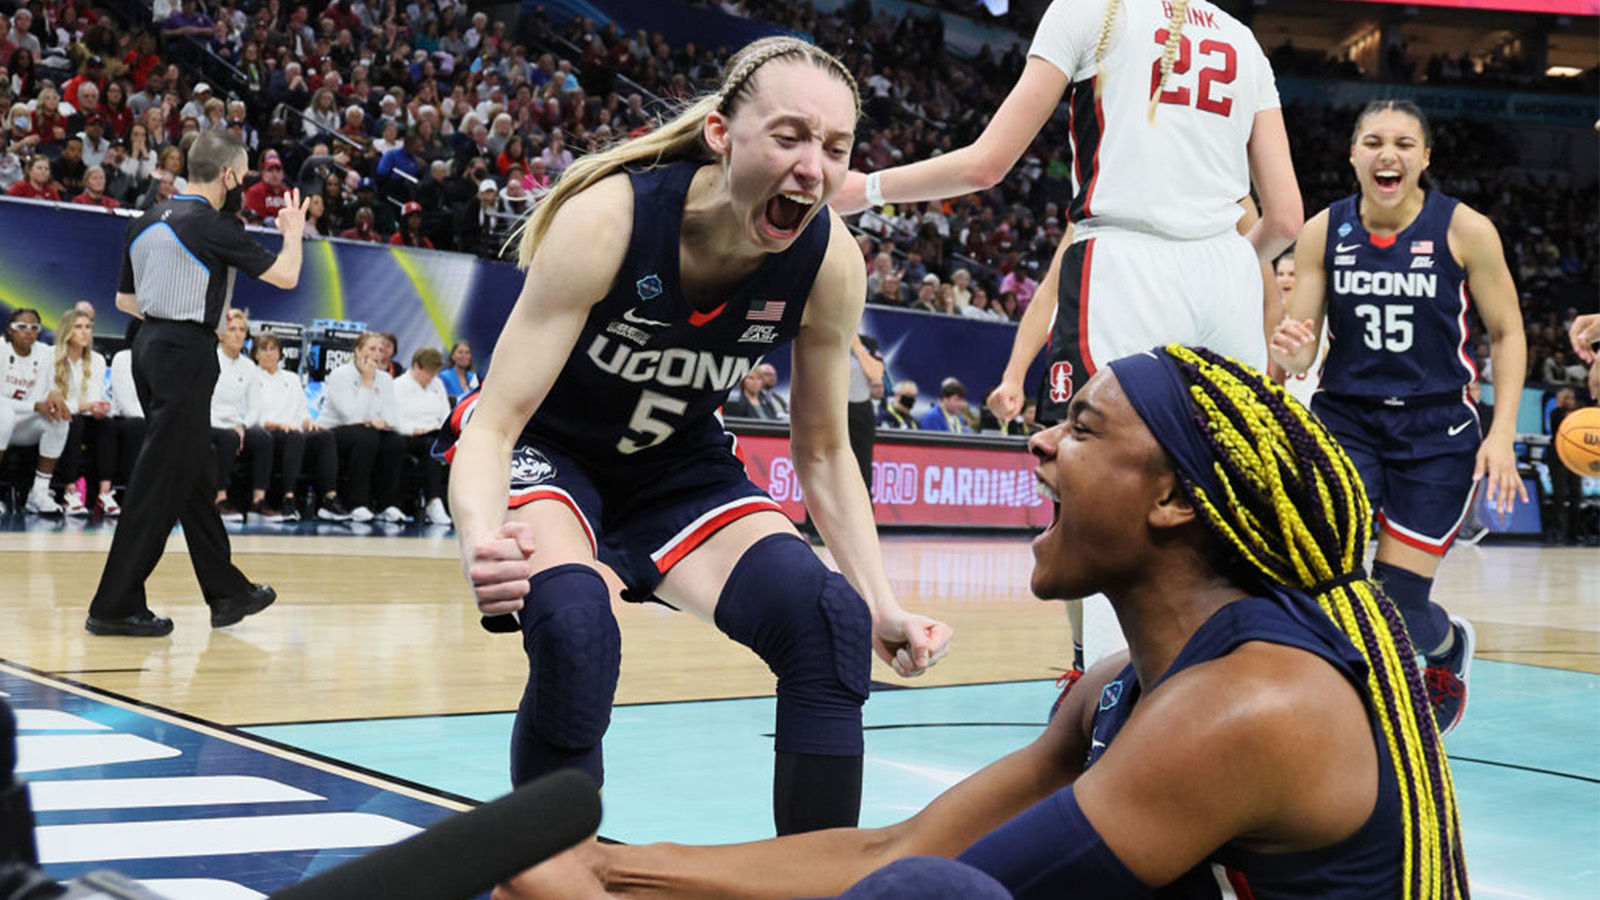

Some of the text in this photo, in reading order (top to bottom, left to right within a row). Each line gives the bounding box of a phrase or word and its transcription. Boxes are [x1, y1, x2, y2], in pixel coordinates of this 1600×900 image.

[1162, 0, 1220, 29] BINK
[1150, 28, 1237, 117] 22
[1334, 270, 1437, 298] UCONN
[1355, 304, 1414, 353] 35
[587, 334, 765, 392] UCONN
[616, 389, 688, 454] 5
